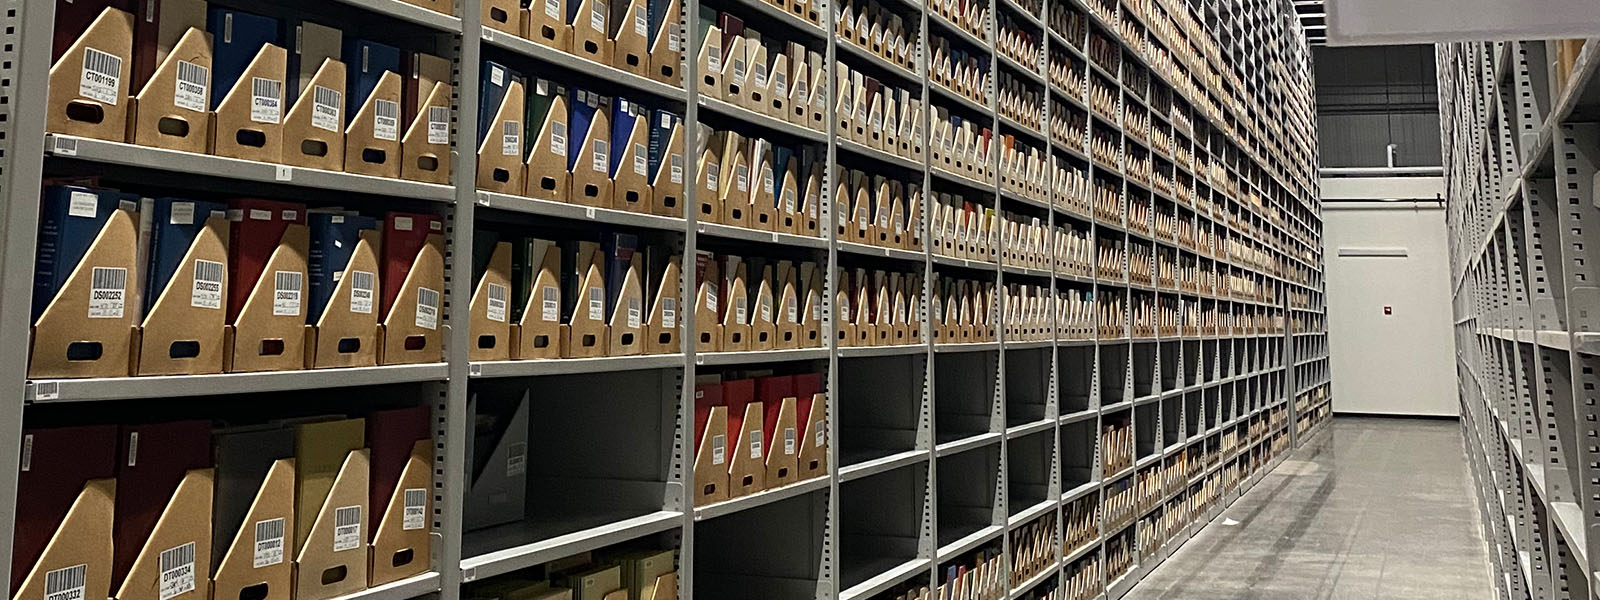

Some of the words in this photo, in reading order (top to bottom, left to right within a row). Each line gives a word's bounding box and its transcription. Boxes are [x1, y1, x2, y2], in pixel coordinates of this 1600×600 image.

[85, 71, 115, 87] CT001199
[94, 290, 122, 300] DS002252
[164, 565, 191, 582] DT000334
